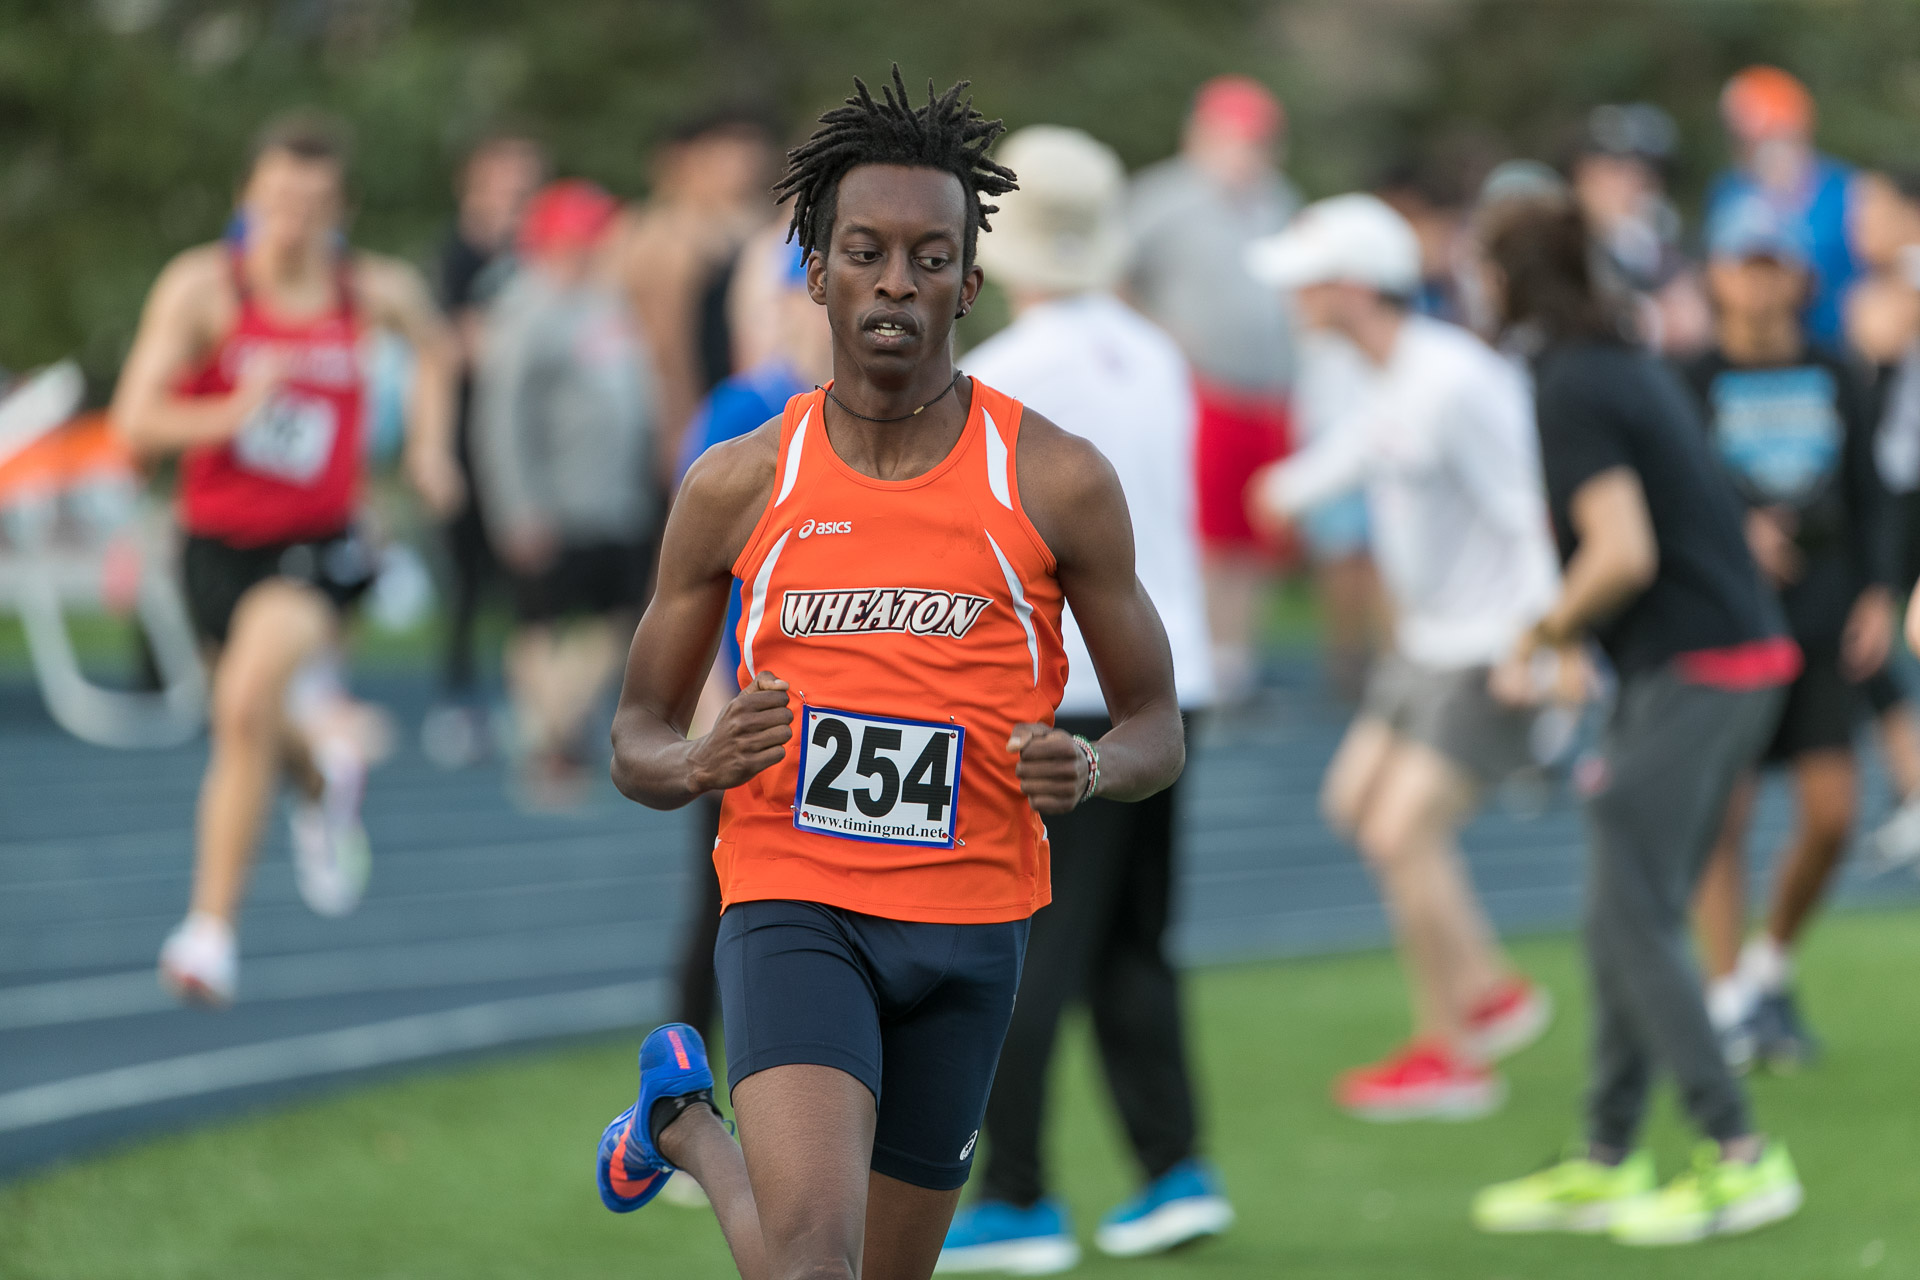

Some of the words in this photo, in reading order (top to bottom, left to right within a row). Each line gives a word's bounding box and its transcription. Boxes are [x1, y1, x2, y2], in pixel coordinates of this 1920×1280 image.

[781, 588, 992, 638] WHEATON
[804, 718, 951, 821] 254
[806, 812, 943, 838] www.timingmd.net
